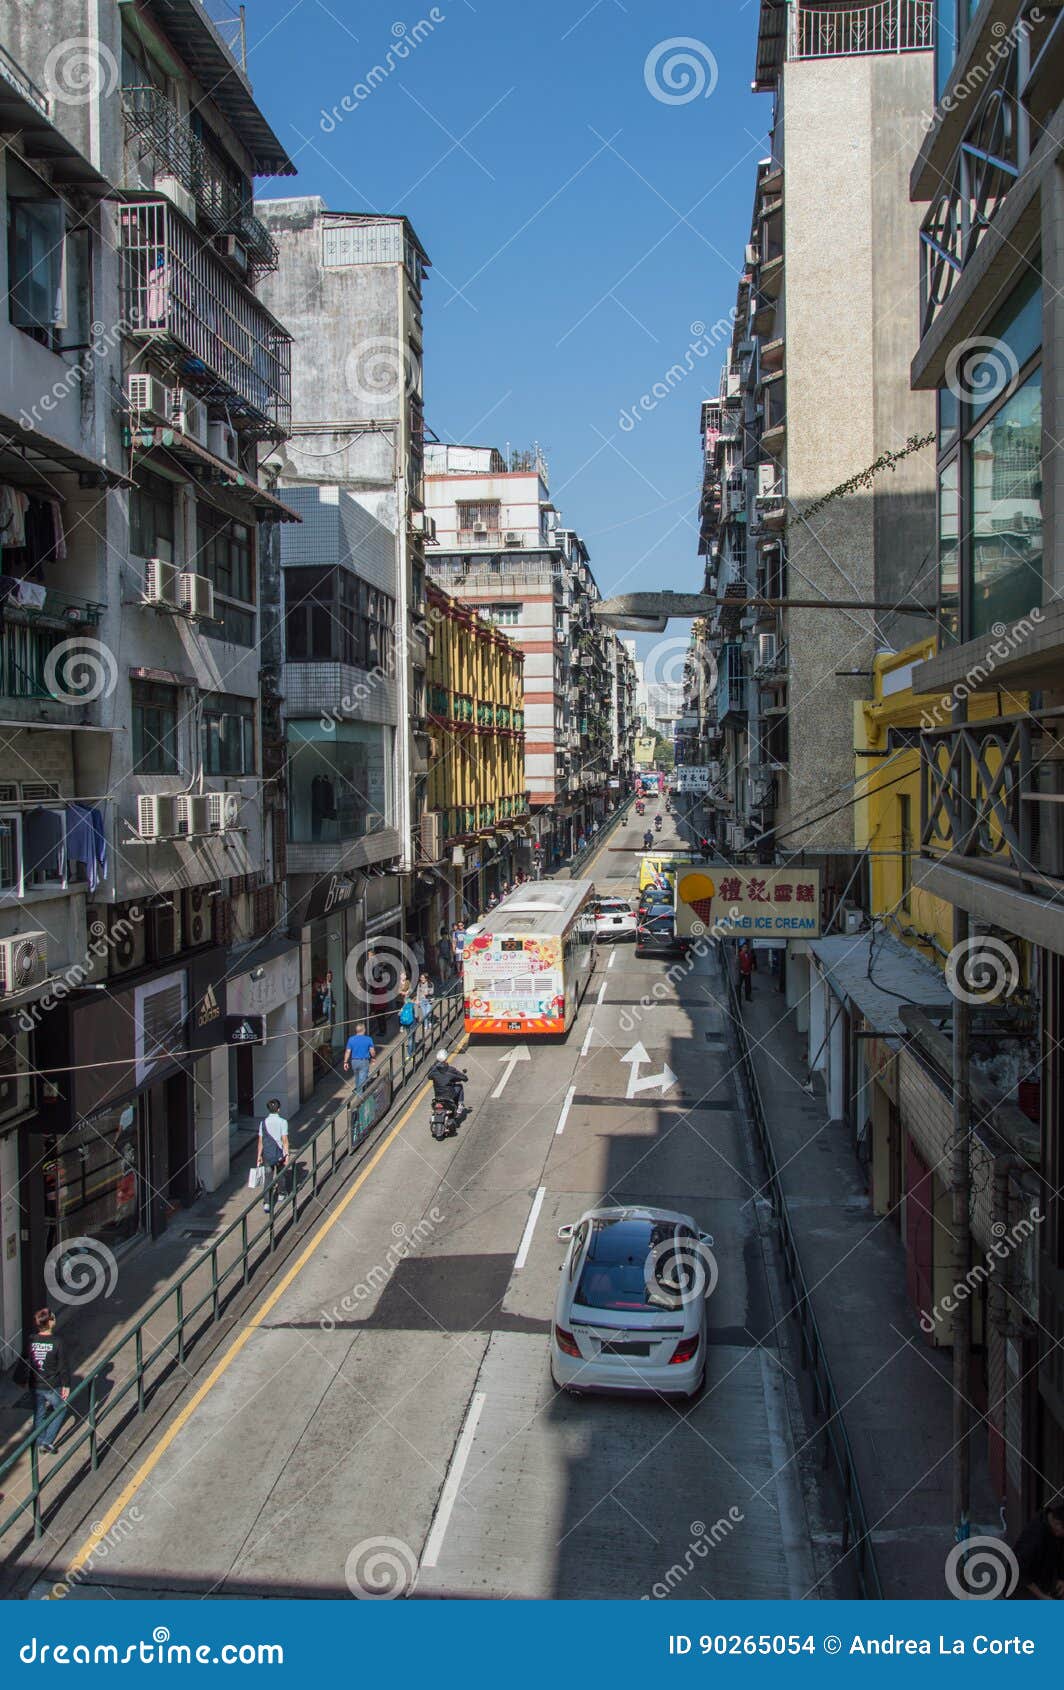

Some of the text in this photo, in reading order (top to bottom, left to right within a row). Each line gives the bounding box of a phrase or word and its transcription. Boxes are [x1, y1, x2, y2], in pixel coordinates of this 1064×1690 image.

[755, 916, 772, 929] ICE
[775, 916, 815, 929] CREAM
[231, 1032, 258, 1041] adidas
